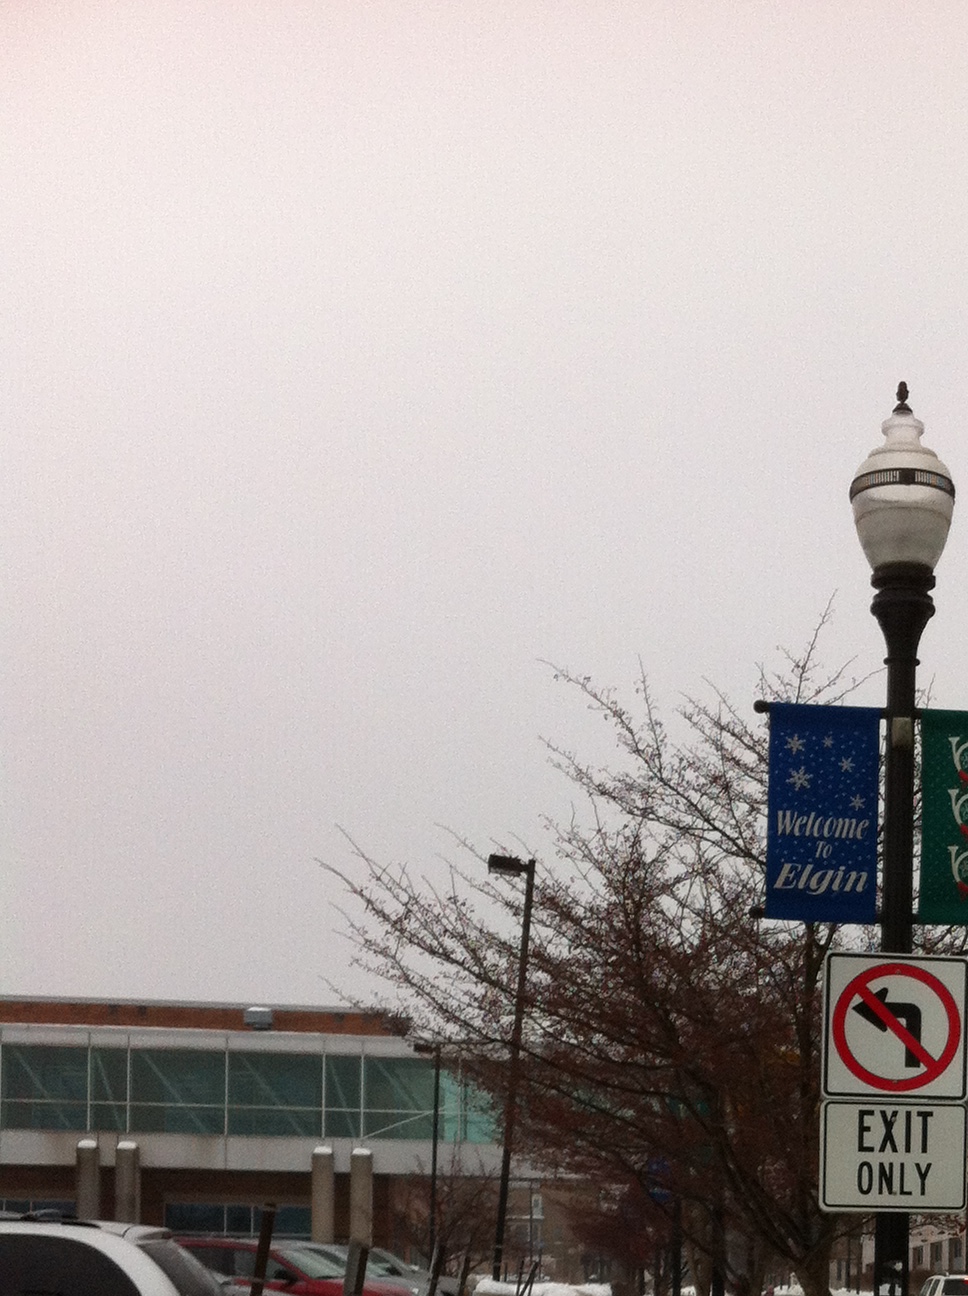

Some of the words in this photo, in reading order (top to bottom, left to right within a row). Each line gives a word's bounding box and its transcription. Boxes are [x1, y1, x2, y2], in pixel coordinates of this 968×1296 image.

[776, 809, 870, 840] Welcome
[773, 863, 868, 895] Elgin
[857, 1109, 934, 1154] EXIT
[856, 1160, 932, 1196] ONLY
